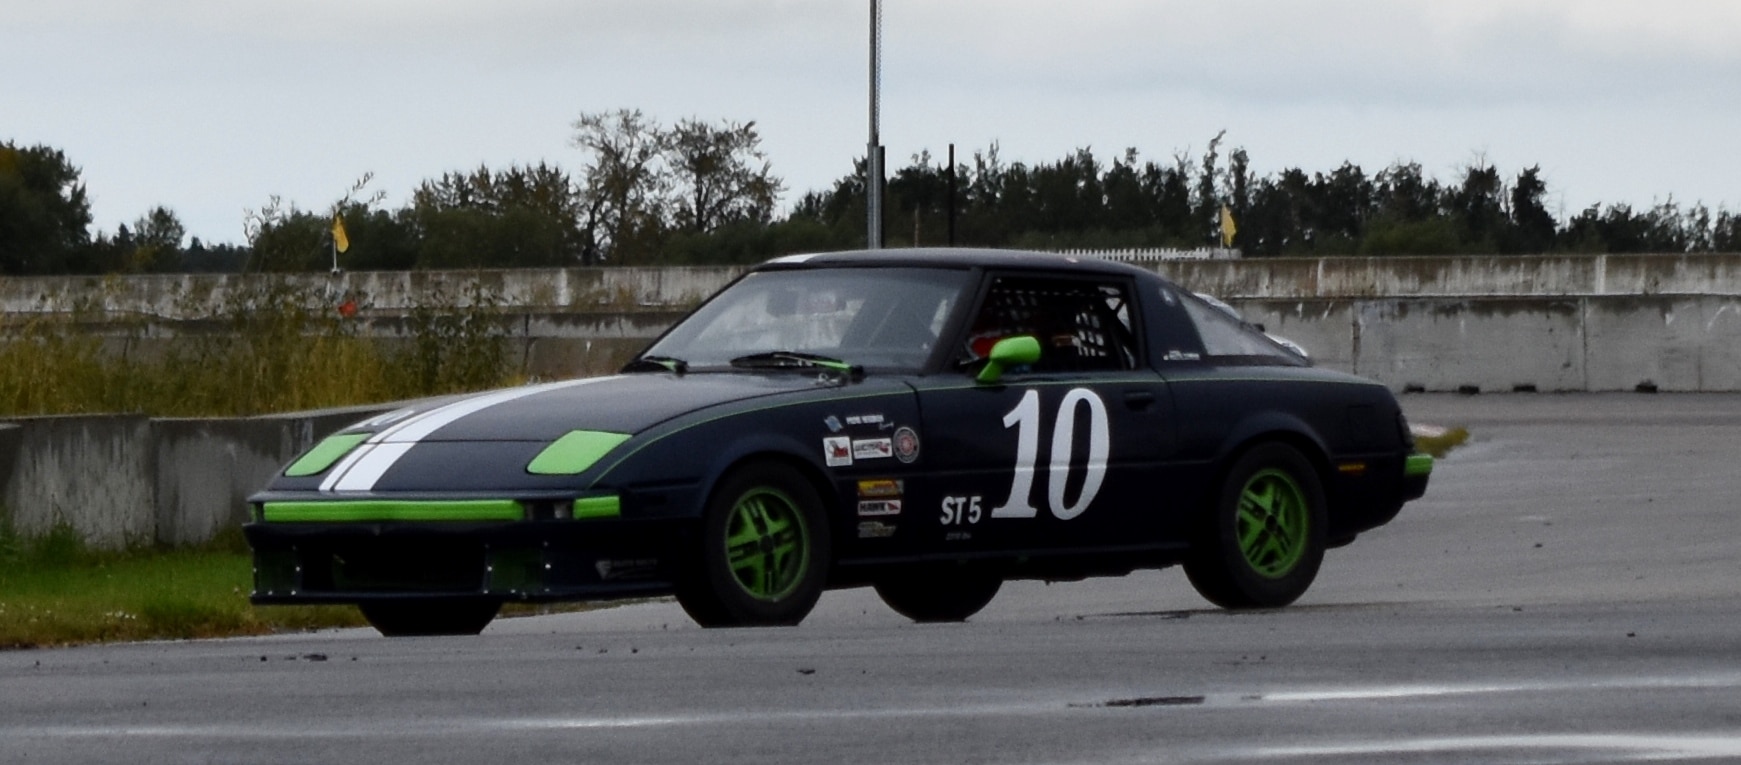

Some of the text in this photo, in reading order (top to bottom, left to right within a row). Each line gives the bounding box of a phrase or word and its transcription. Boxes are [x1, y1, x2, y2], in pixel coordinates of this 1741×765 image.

[991, 387, 1110, 520] 10
[940, 496, 982, 525] ST 5
